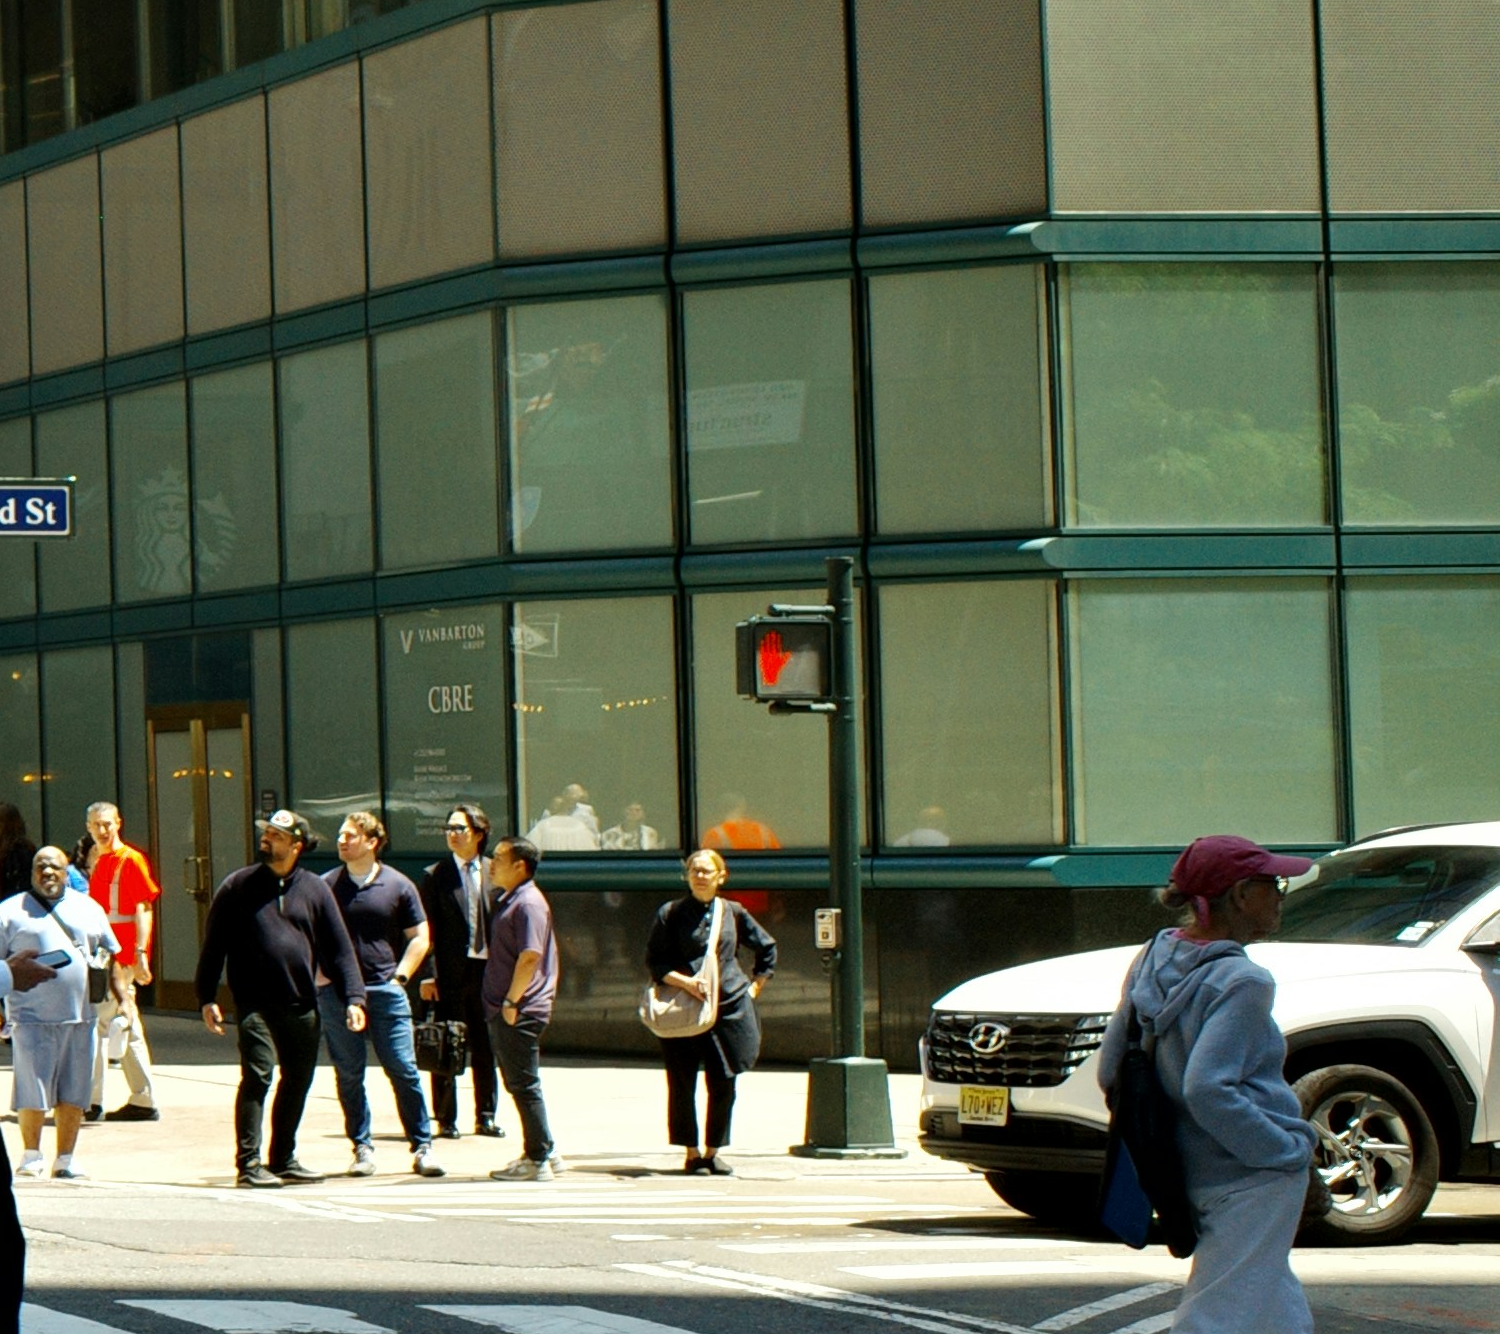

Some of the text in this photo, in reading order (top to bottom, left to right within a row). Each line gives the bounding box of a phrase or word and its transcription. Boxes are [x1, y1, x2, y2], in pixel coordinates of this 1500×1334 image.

[25, 497, 57, 526] St
[418, 623, 485, 643] VANBARTON
[428, 684, 474, 714] CBRE
